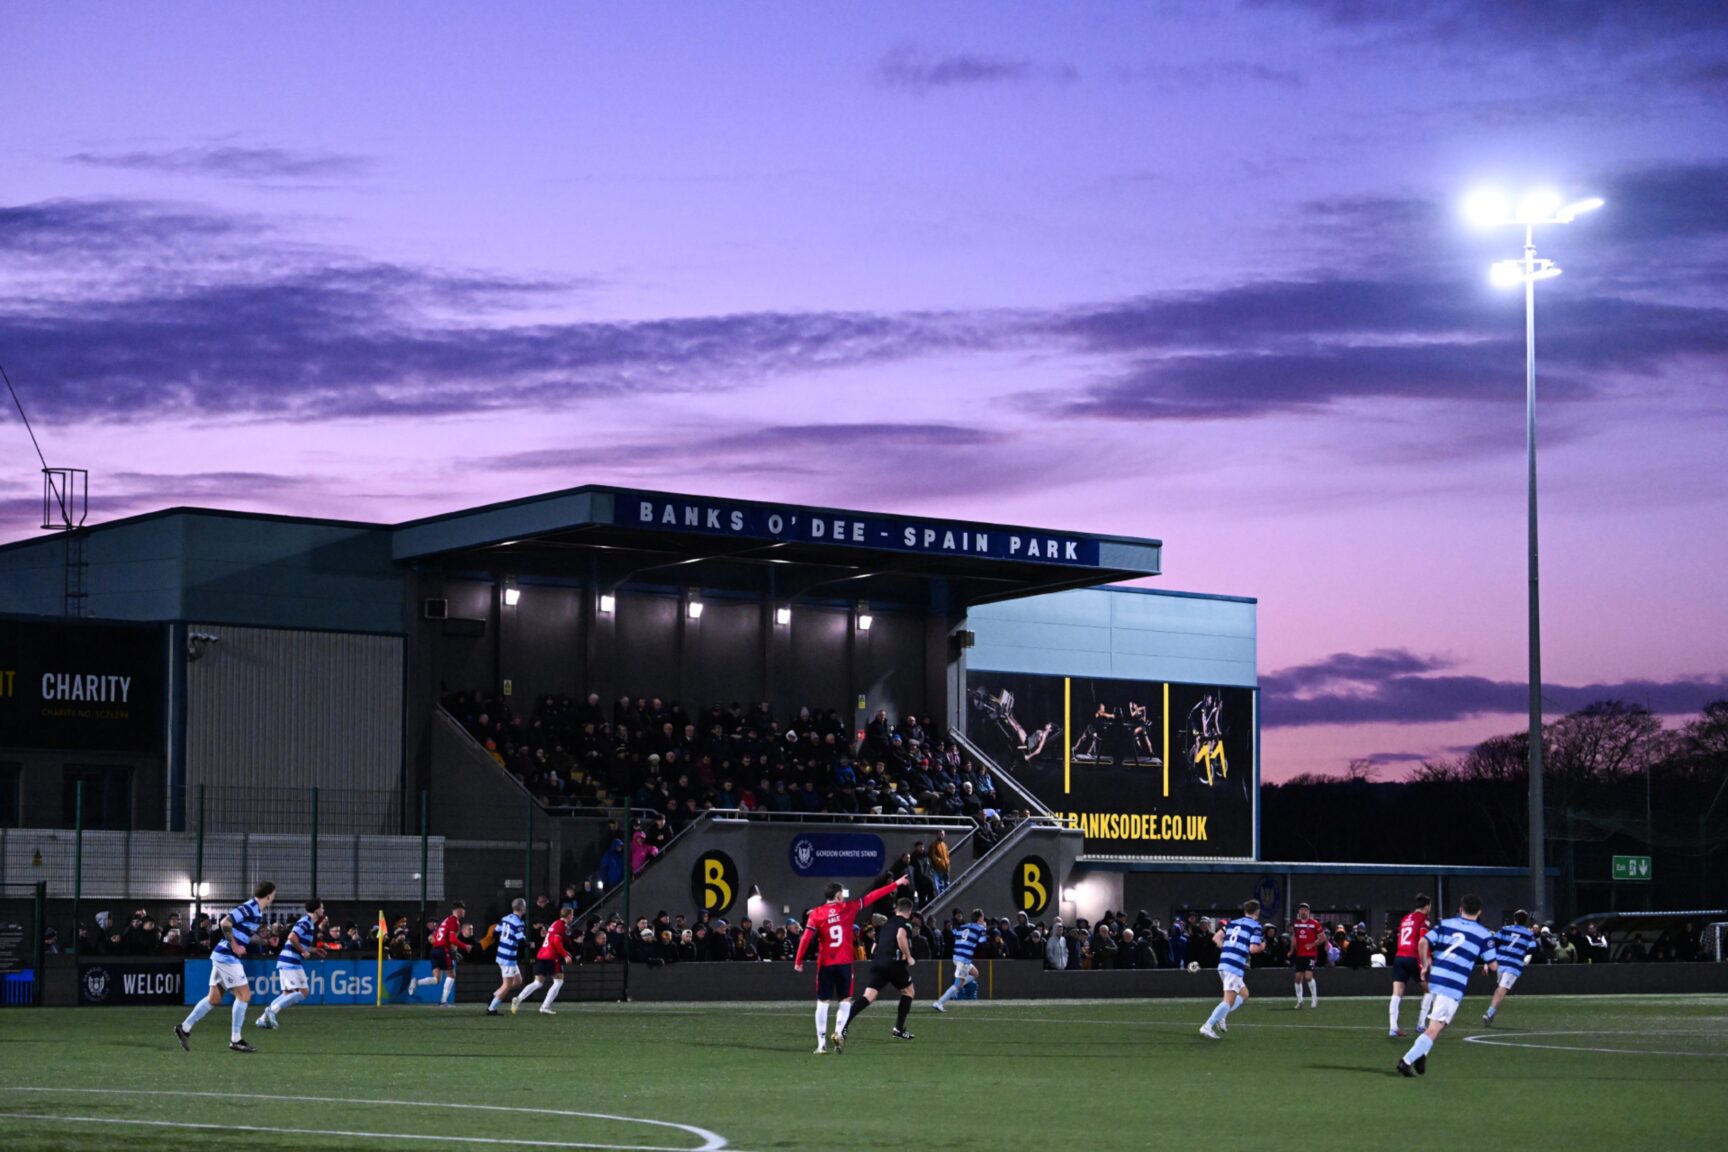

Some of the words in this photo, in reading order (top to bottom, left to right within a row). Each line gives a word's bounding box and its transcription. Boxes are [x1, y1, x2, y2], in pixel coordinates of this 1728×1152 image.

[639, 501, 744, 532] BANKS
[768, 513, 797, 535] O'
[811, 518, 866, 542] DEE
[904, 527, 989, 553] SPAIN
[1009, 536, 1079, 561] PARK
[41, 672, 131, 703] CHARITY
[815, 850, 838, 858] GORDON
[838, 850, 860, 858] CHRISTIE
[860, 850, 878, 858] STAND
[829, 925, 843, 948] 9
[960, 928, 971, 943] 9
[1228, 925, 1242, 945] 8
[1400, 926, 1413, 946] 12
[1508, 932, 1521, 951] 7
[331, 970, 373, 995] Gas
